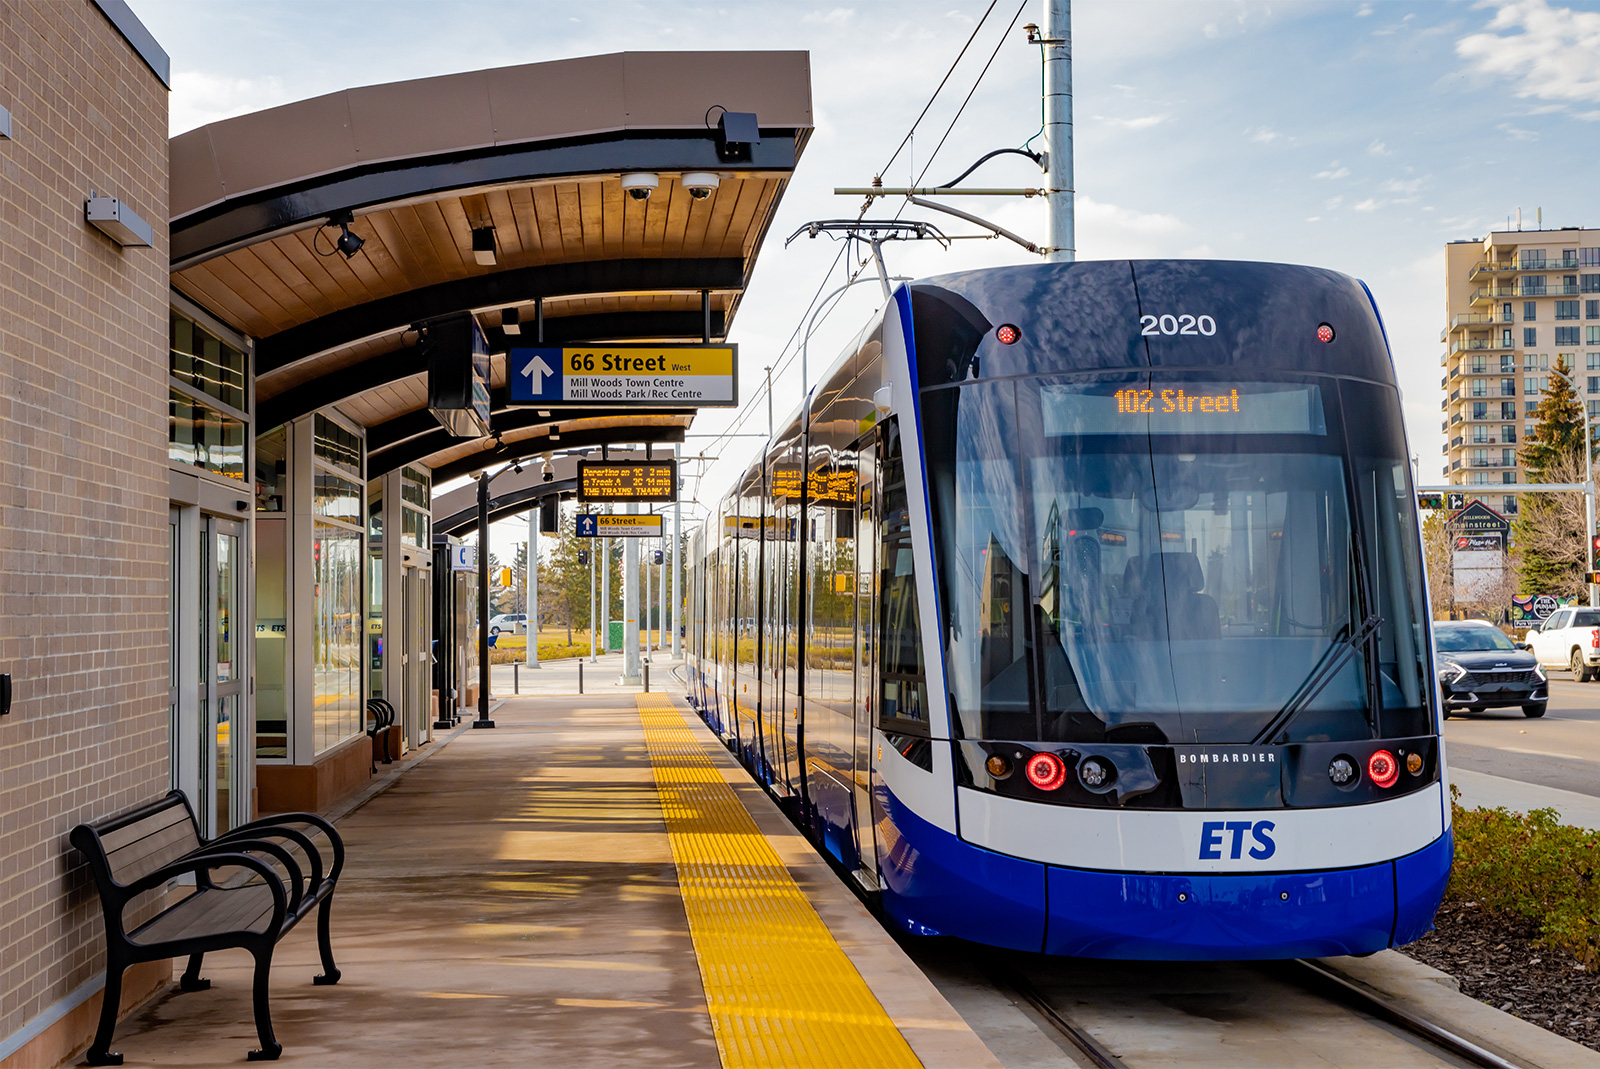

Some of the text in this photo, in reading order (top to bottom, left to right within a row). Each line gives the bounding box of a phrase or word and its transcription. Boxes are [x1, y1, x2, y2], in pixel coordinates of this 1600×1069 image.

[1140, 314, 1217, 336] 2020
[570, 353, 691, 371] 66 Street West
[570, 378, 685, 387] Mill Woods Town Centre
[570, 389, 588, 398] Mill
[591, 389, 623, 398] Woods
[671, 389, 702, 398] Centre
[1114, 389, 1240, 413] 102 Street
[656, 467, 671, 477] min
[656, 477, 671, 486] min
[600, 517, 610, 525] 66
[612, 517, 636, 525] Street
[256, 624, 286, 632] TS ETS
[1180, 753, 1275, 763] BOMBARDIER
[1198, 820, 1276, 860] ETS
